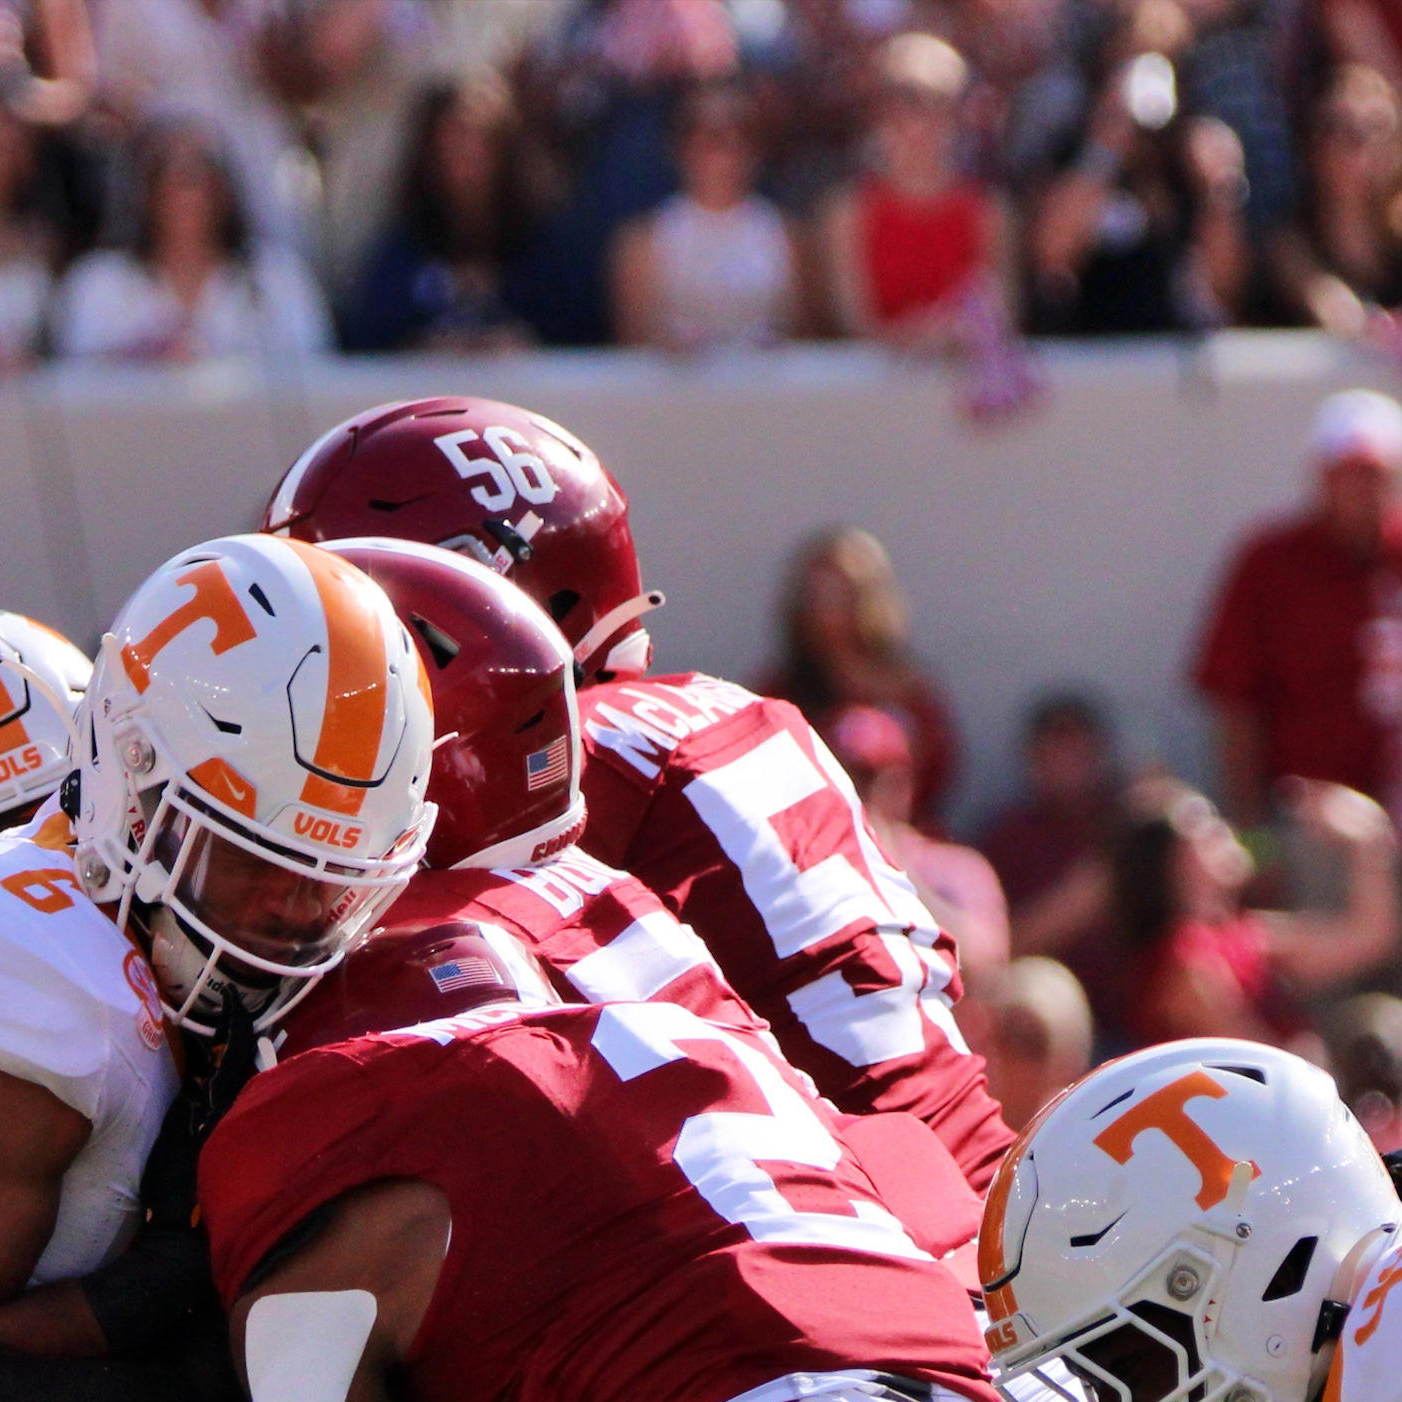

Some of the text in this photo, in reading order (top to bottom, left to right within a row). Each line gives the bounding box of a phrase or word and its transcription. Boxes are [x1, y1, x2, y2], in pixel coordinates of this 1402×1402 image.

[434, 426, 558, 512] 56
[122, 562, 258, 695] T
[294, 811, 362, 849] VOLS
[0, 868, 82, 914] 6
[591, 1002, 936, 1262] 2
[1093, 1072, 1262, 1212] T
